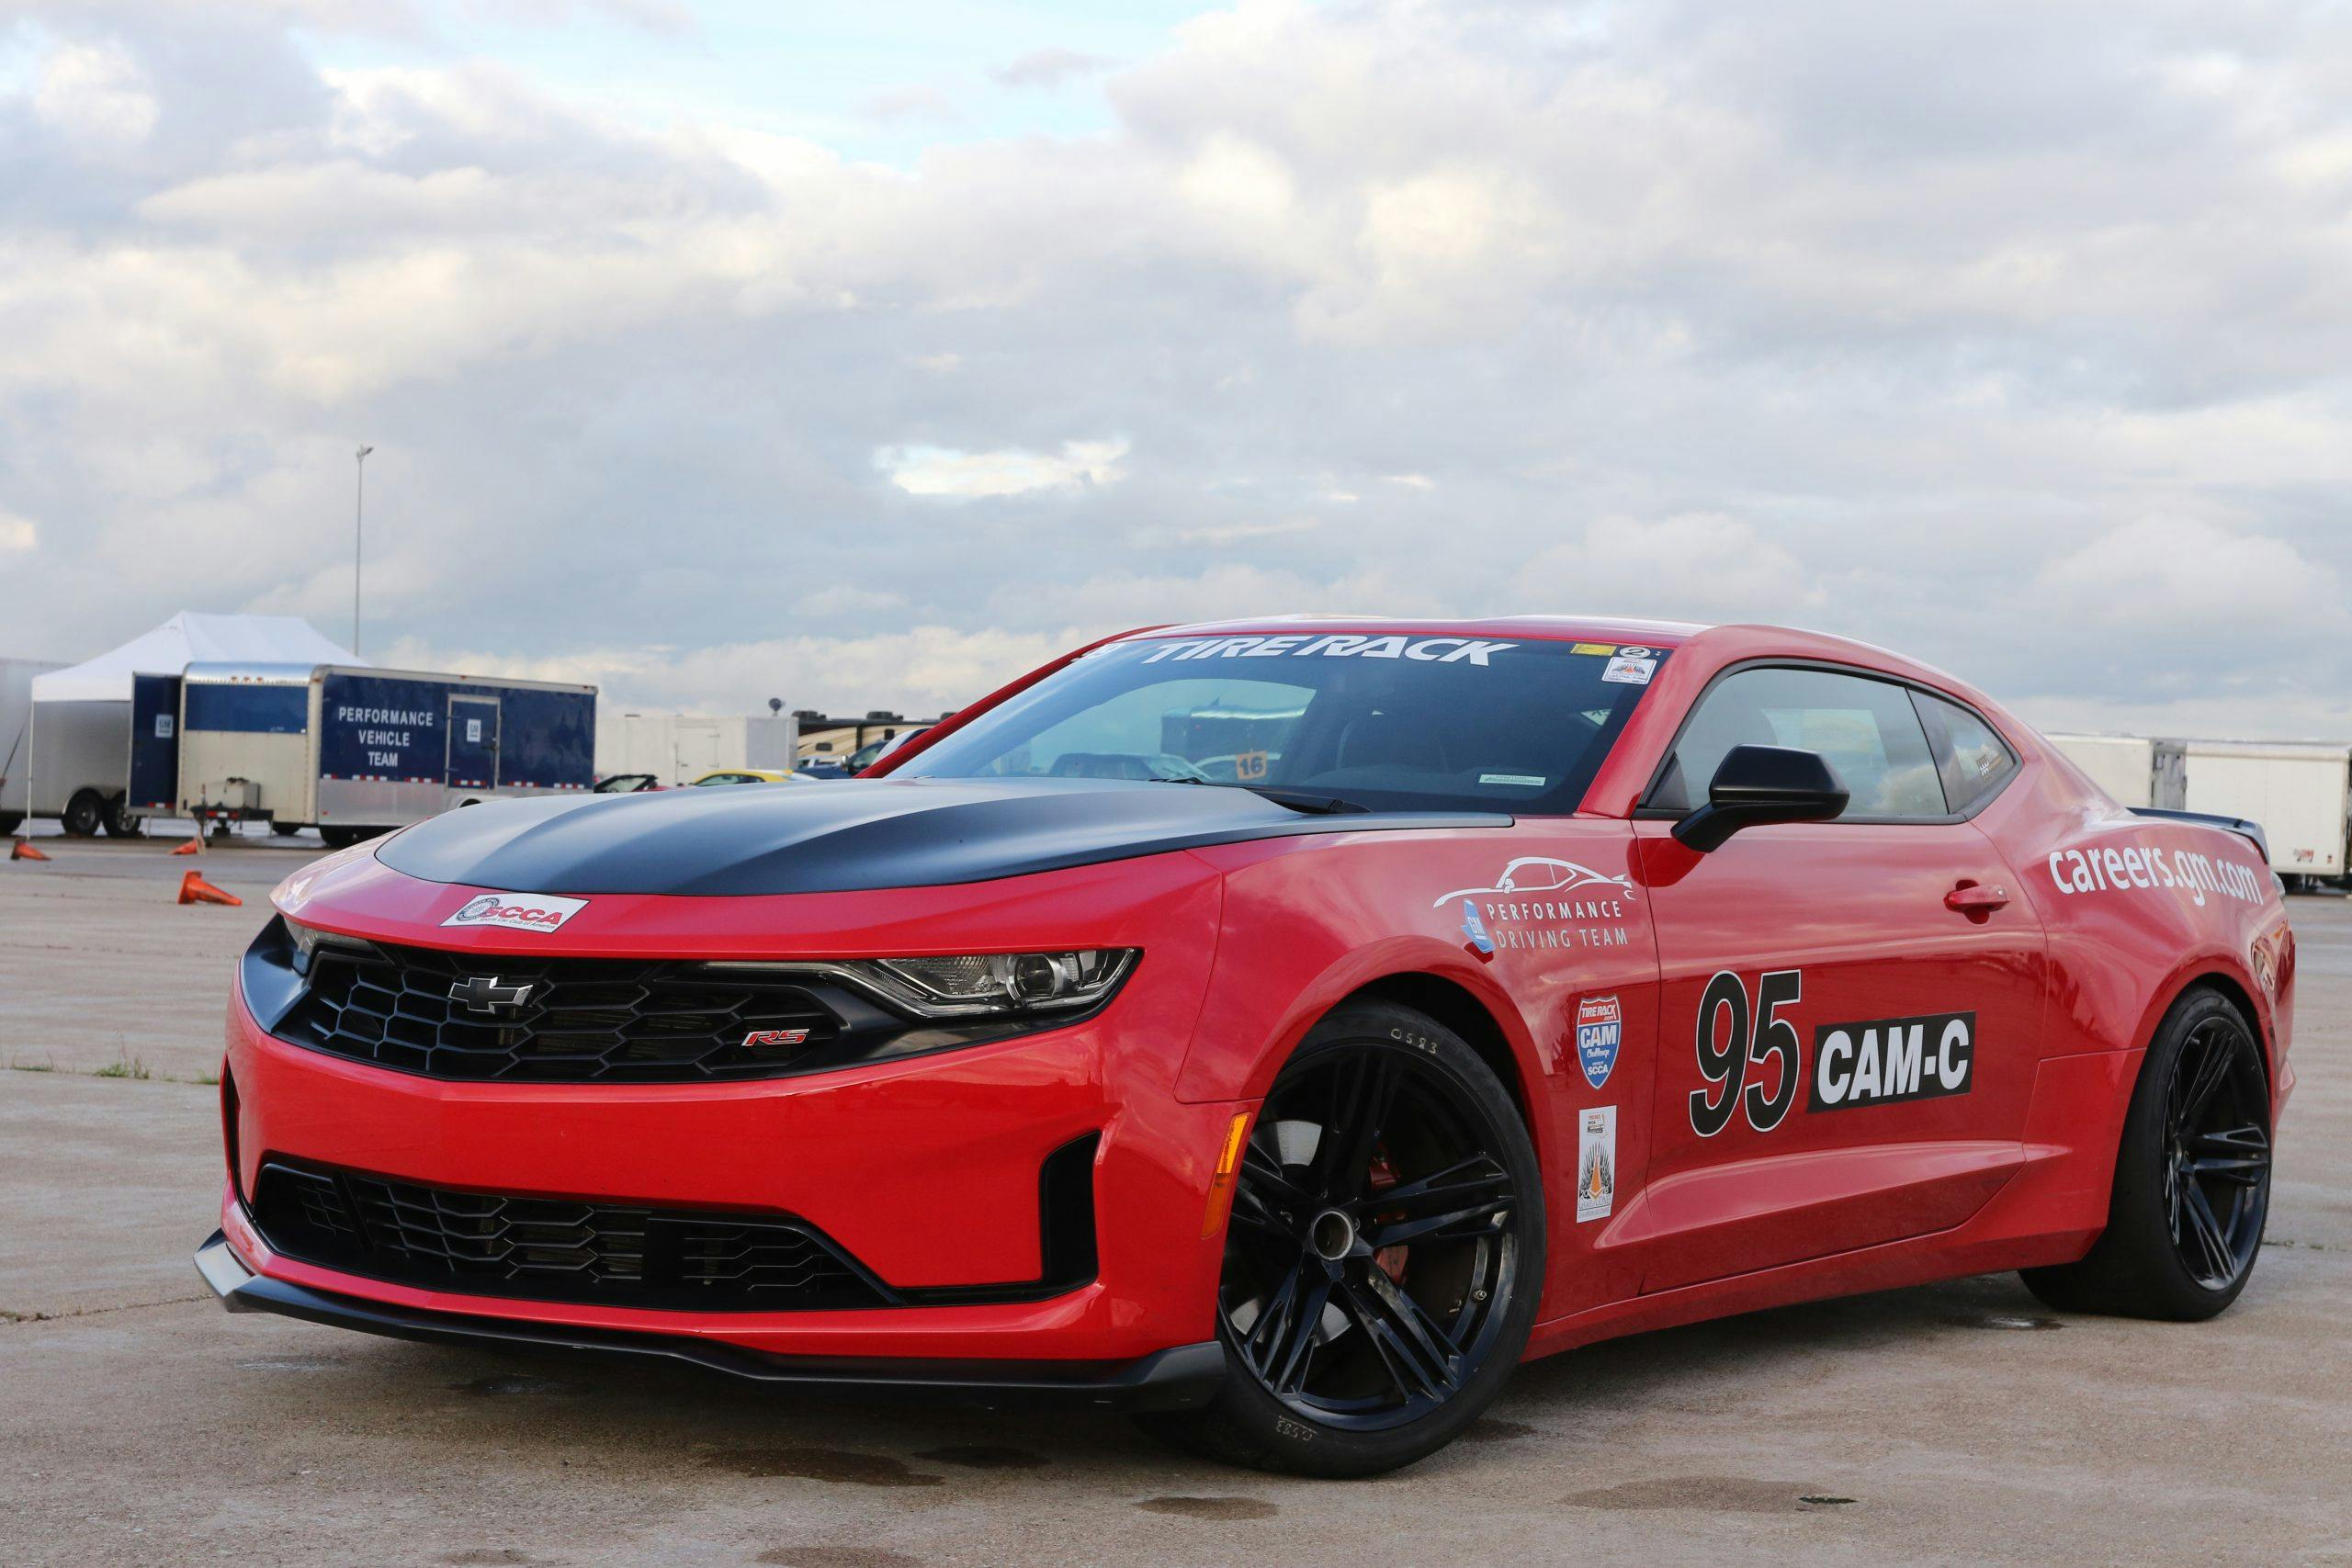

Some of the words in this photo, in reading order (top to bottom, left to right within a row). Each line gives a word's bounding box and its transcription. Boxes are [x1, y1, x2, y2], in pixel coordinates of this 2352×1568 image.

[1141, 636, 1323, 664] TIRE
[1293, 635, 1521, 667] RACK
[338, 706, 434, 727] PERFORMANCE
[358, 729, 410, 747] VEHICLE
[368, 751, 398, 767] TEAM
[1238, 756, 1264, 775] 16
[2049, 847, 2264, 907] careers.gm.com
[481, 906, 563, 925] SCCA
[1486, 900, 1622, 920] PERFORMANCE
[1467, 916, 1486, 936] GM
[1496, 930, 1571, 949] DRIVING
[1579, 928, 1628, 947] TEAM
[1581, 1007, 1598, 1019] TIRE
[1597, 1004, 1617, 1020] RACK
[741, 1029, 809, 1046] RS
[1580, 1024, 1617, 1048] CAM
[1690, 969, 1801, 1137] 95
[1817, 1019, 1970, 1104] CAM-C
[1588, 1065, 1609, 1076] SCCA
